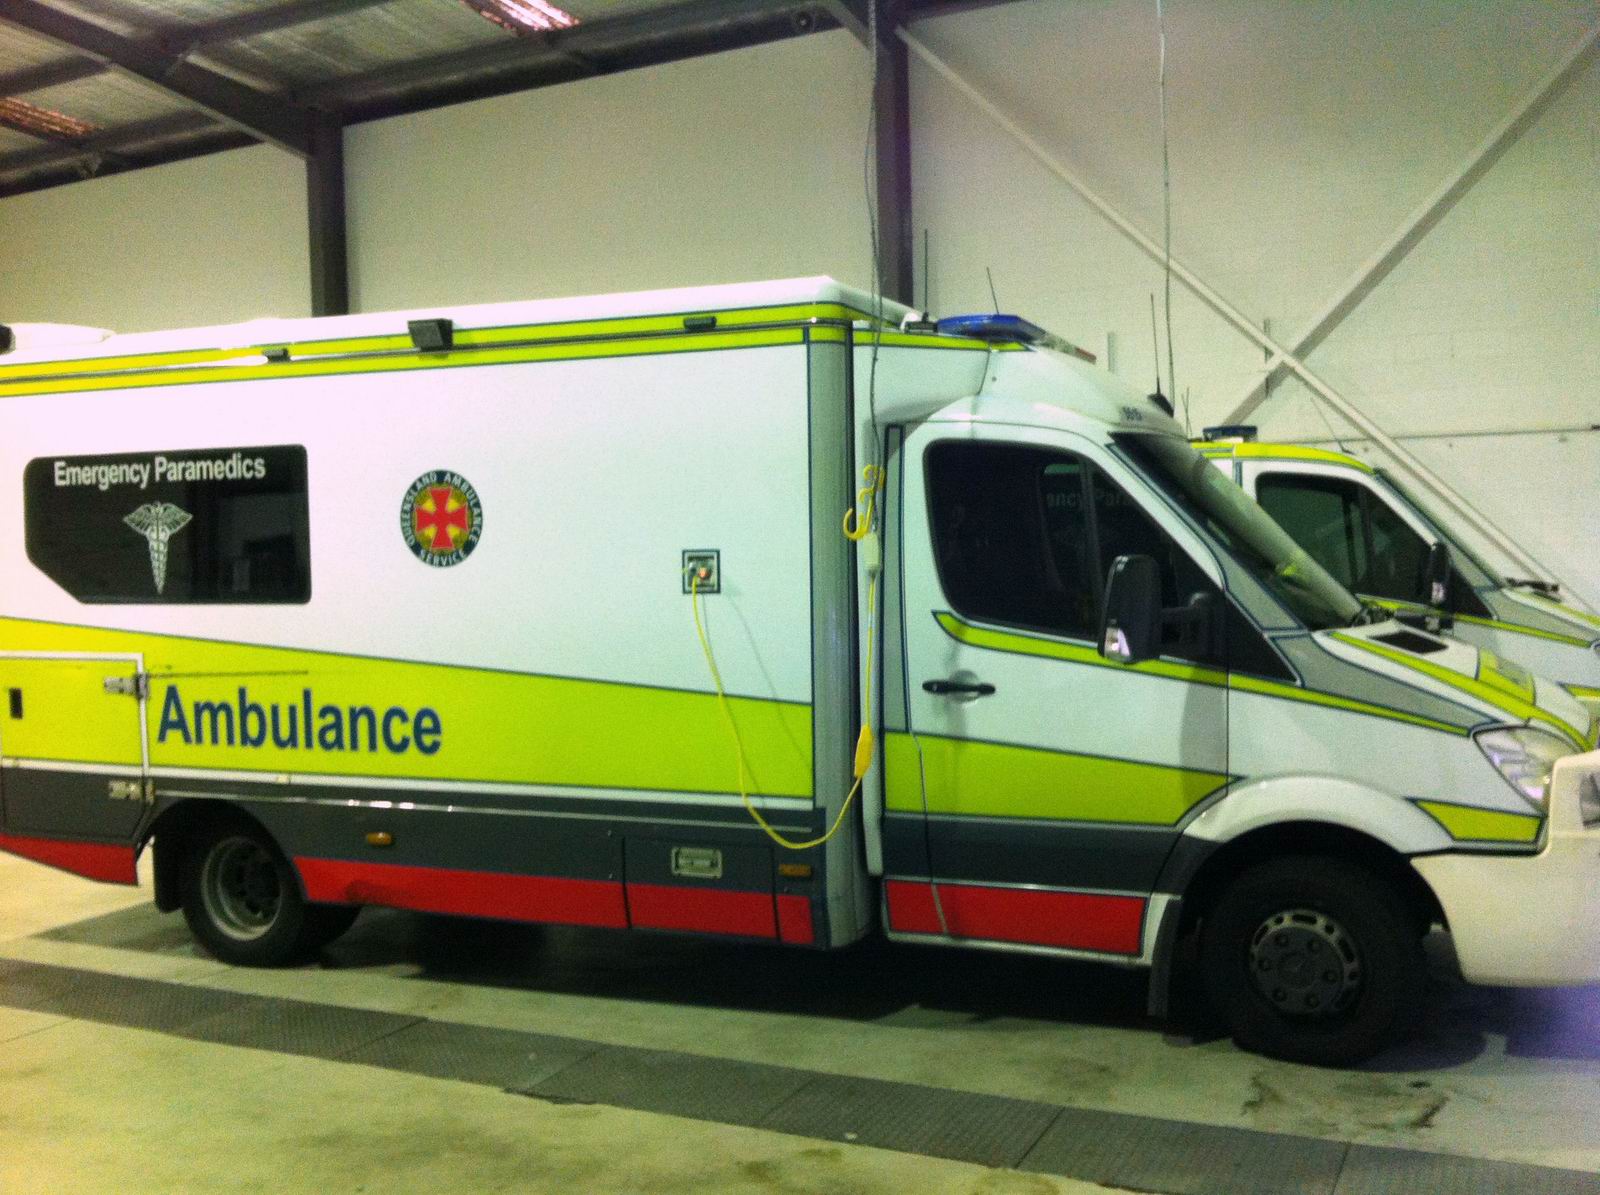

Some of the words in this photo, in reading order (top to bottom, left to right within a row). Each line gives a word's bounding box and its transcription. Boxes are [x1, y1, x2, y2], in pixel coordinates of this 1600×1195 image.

[54, 460, 150, 490] Emergency
[154, 453, 266, 482] Paramedics
[401, 471, 437, 546] QUEENSLAND
[443, 471, 482, 544] AMBULANCE
[420, 548, 467, 567] SERVICE
[157, 685, 442, 755] Ambulance
